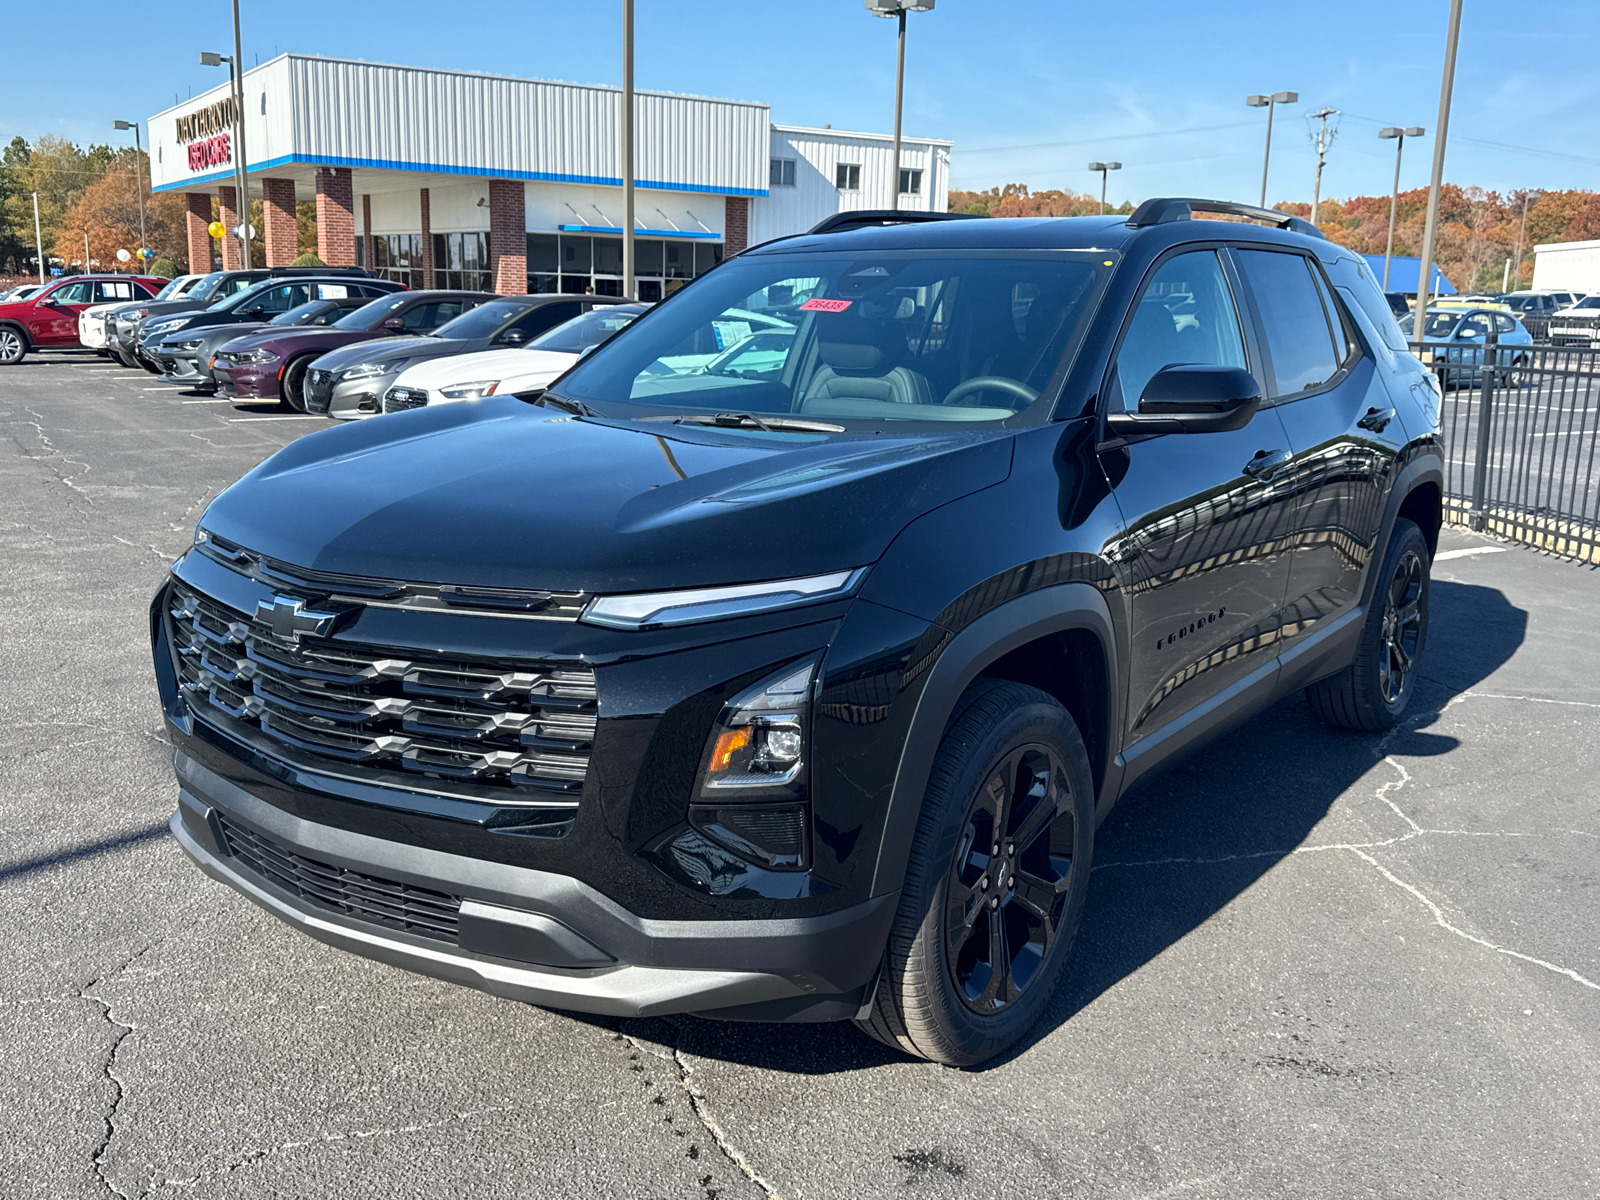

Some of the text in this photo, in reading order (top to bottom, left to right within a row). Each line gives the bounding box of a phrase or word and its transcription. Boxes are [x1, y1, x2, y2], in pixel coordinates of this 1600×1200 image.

[175, 114, 196, 144] JOHN
[187, 133, 229, 170] USED CARS
[807, 300, 844, 310] 26438
